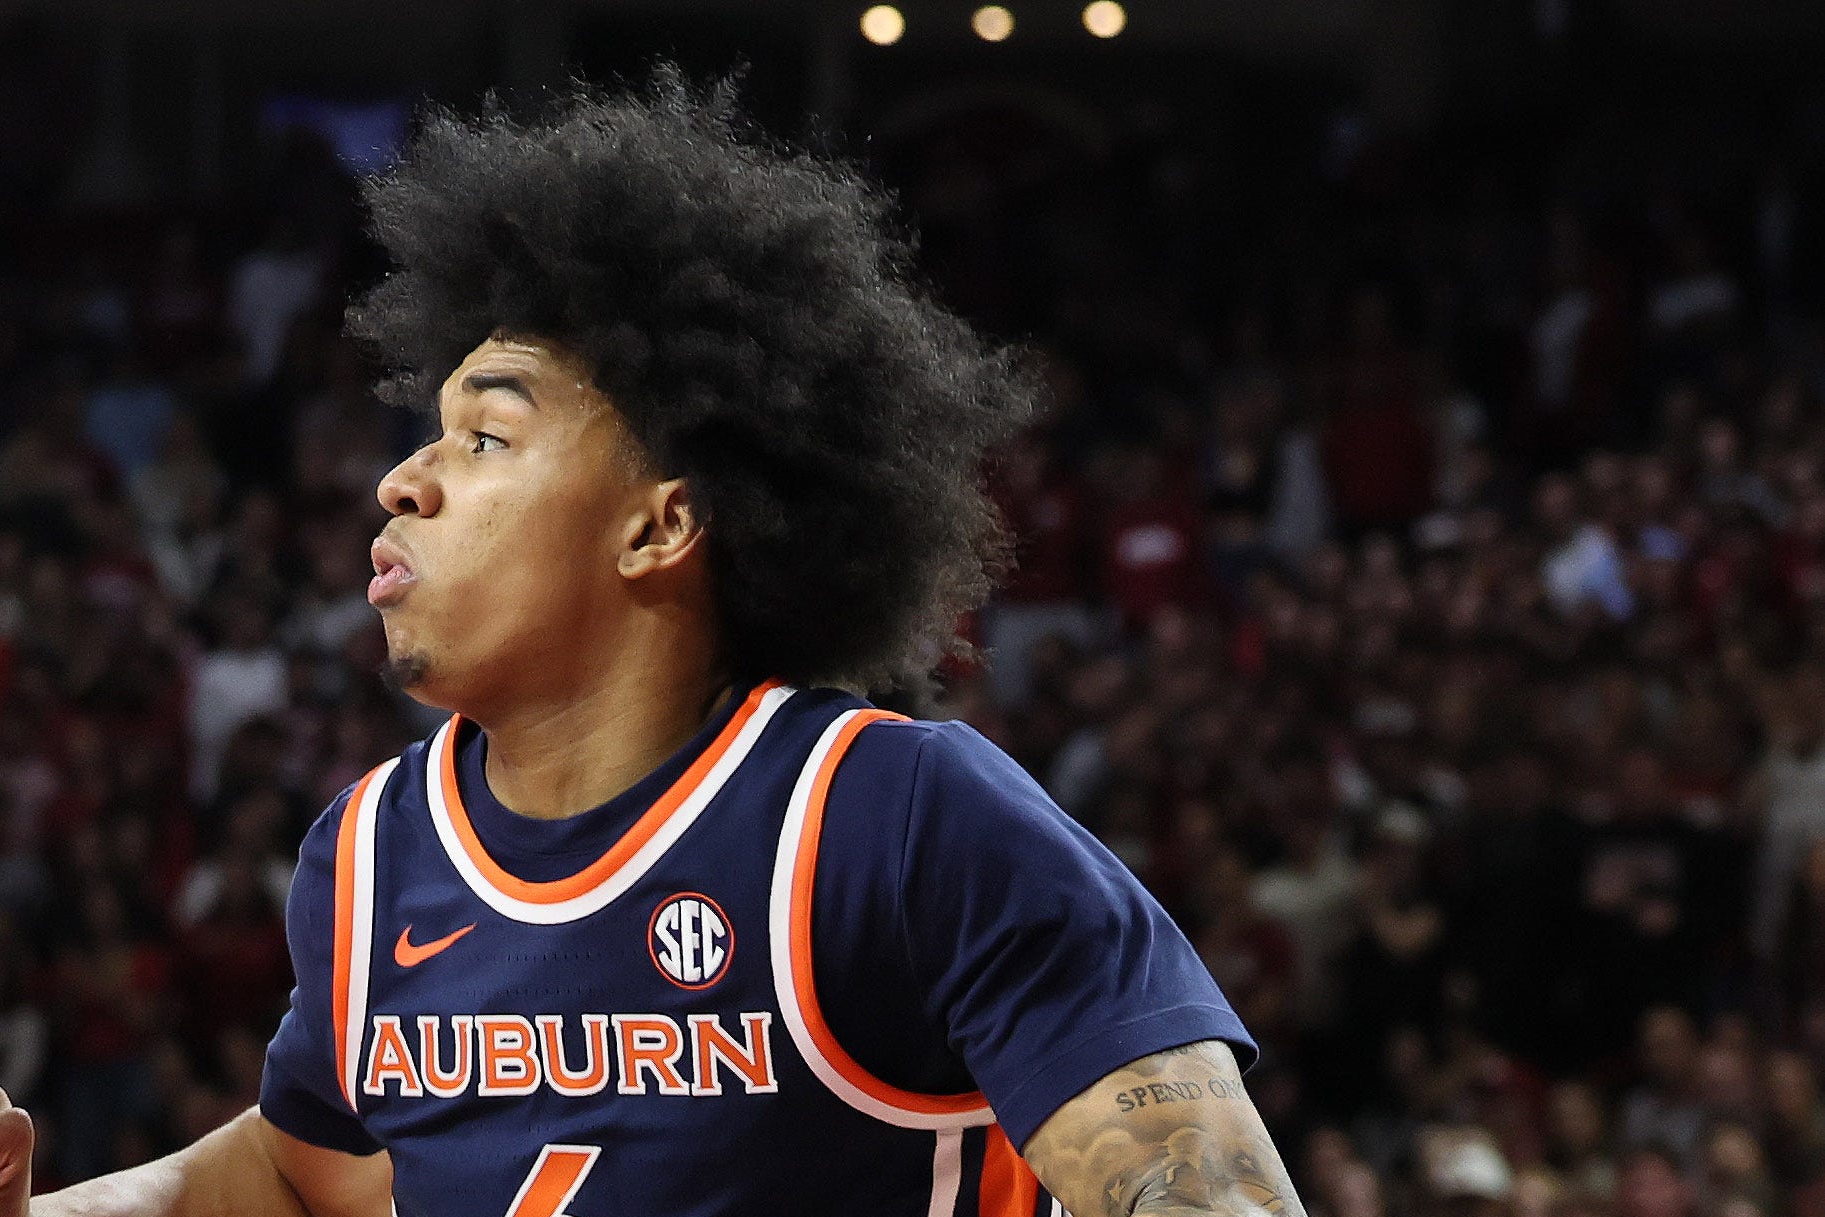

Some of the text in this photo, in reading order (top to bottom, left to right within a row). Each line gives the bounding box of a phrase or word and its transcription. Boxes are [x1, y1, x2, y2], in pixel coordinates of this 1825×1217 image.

[653, 899, 728, 982] SEC
[363, 1011, 779, 1097] AUBURN
[1115, 1080, 1203, 1113] SPEND
